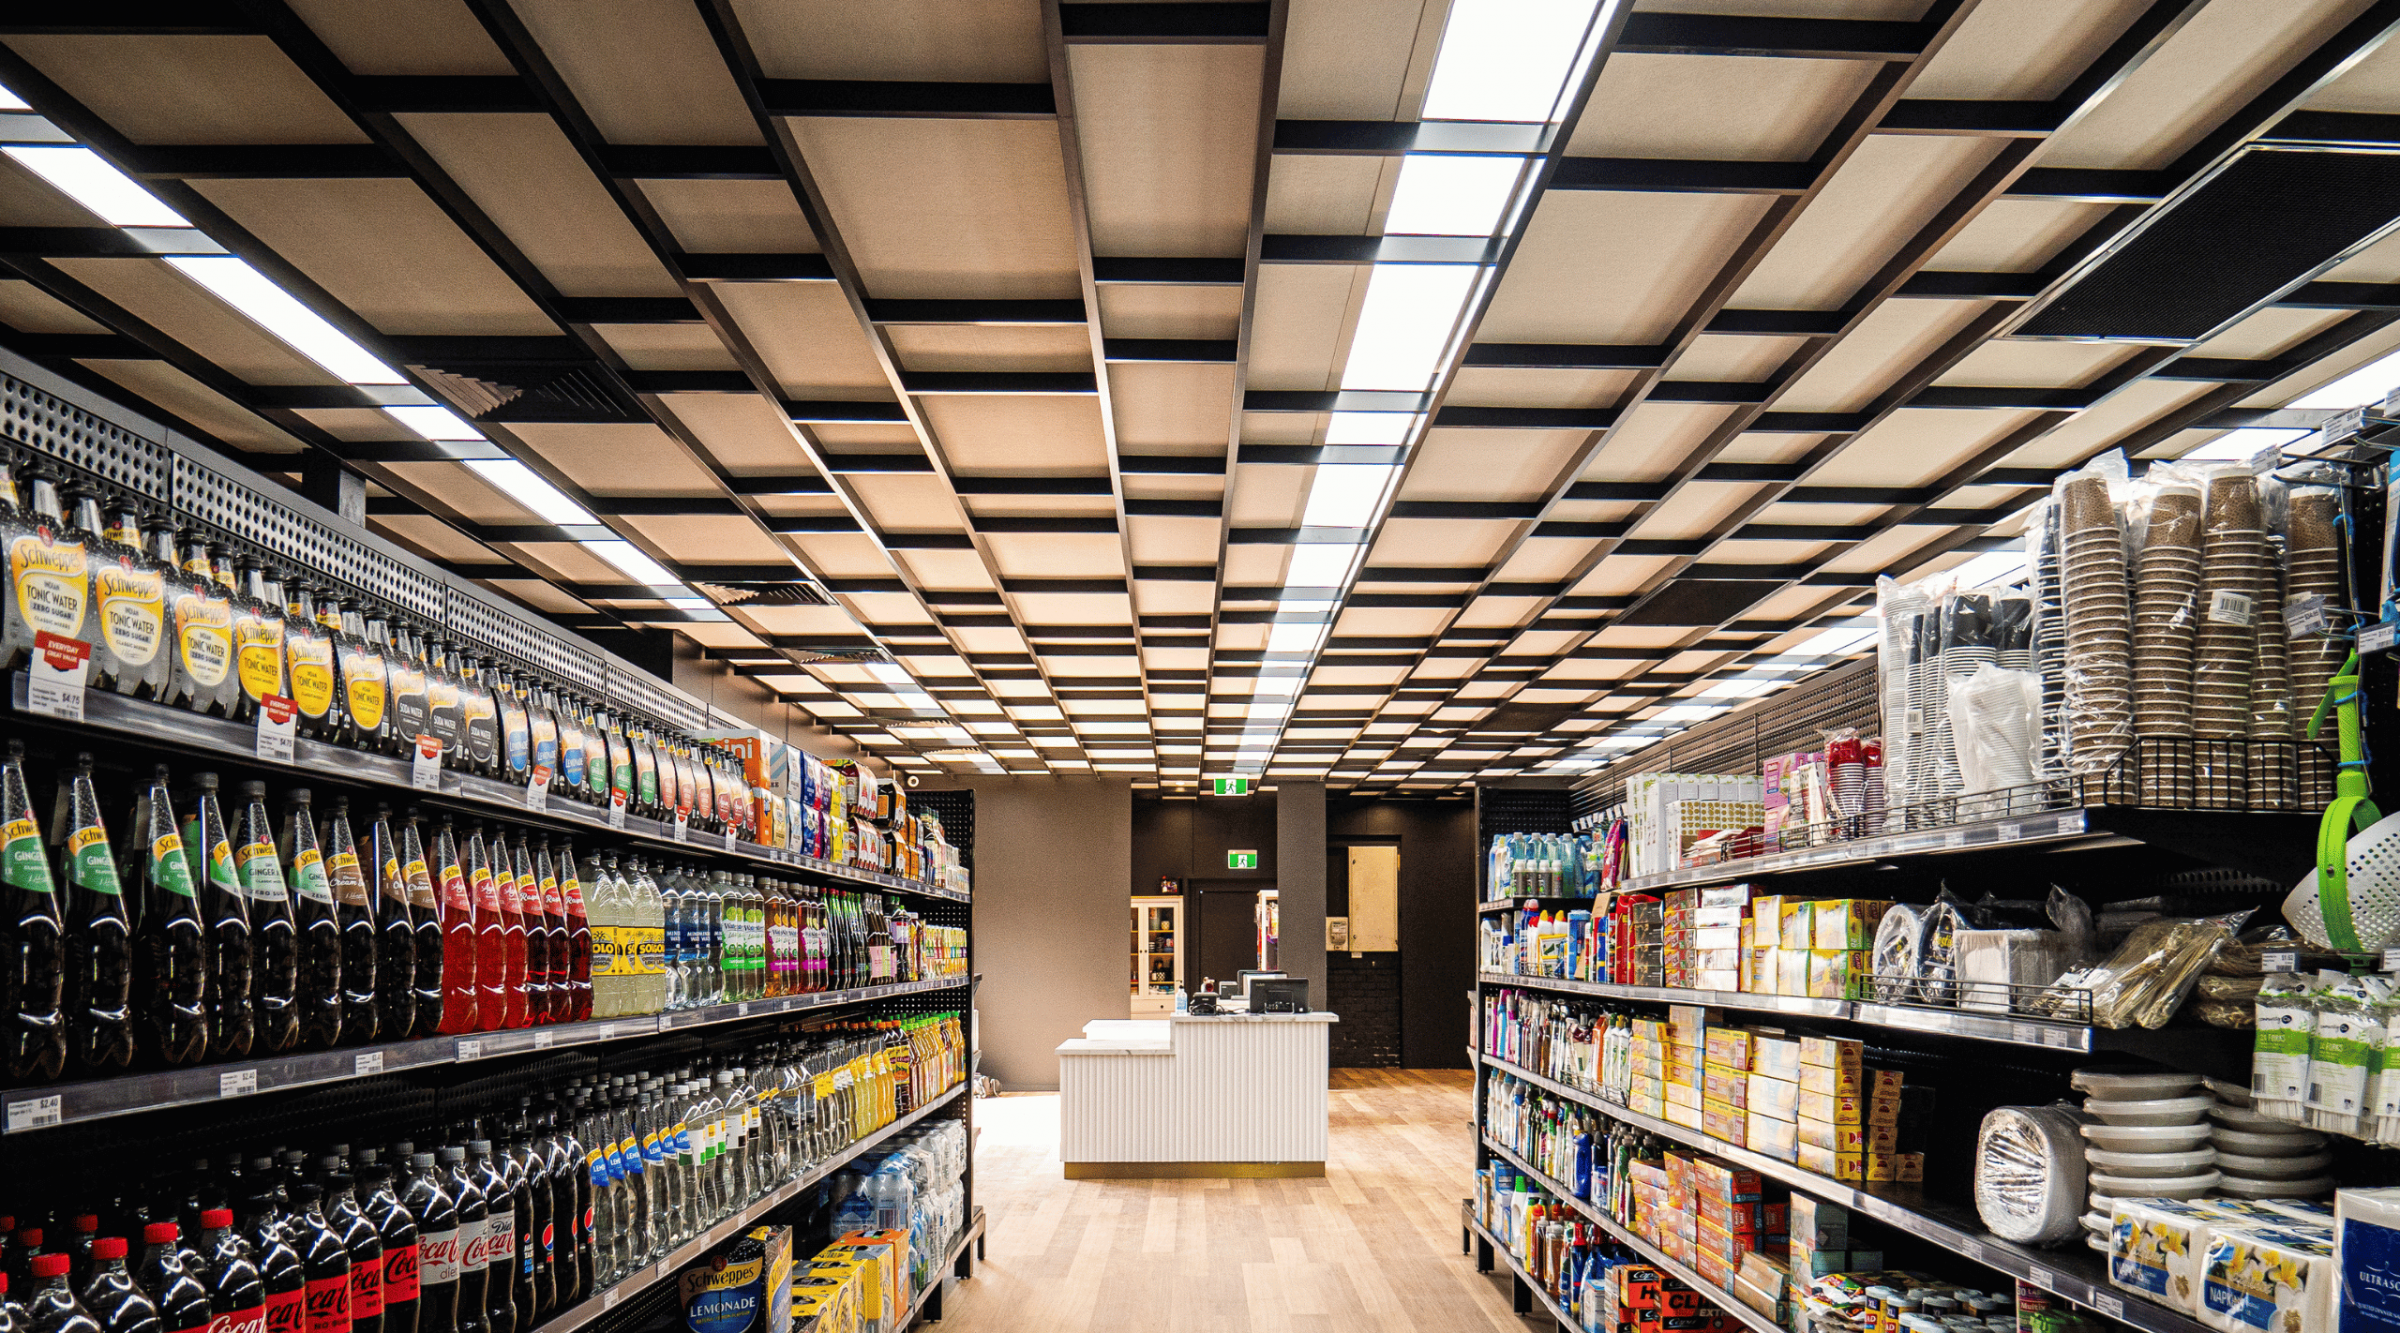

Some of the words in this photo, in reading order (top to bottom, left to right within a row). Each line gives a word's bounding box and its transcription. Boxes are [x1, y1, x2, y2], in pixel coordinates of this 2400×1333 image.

[20, 543, 81, 573] Schweppes
[104, 573, 157, 602] Schweppes
[26, 584, 51, 602] TONIC
[51, 593, 78, 612] WATER
[32, 603, 50, 614] ZERO
[51, 607, 74, 620] SUGAR
[109, 611, 131, 629] TONIC
[132, 618, 155, 635] WATER
[46, 650, 62, 660] GREAT
[62, 653, 78, 663] VALUE
[47, 640, 79, 654] EVERYDAY
[187, 636, 206, 652] TONIC
[206, 643, 225, 658] WATER
[244, 657, 261, 673] TONIC
[261, 662, 278, 677] WATER
[62, 693, 80, 705] $4.75
[15, 851, 43, 862] GINGE
[593, 943, 614, 954] OLO
[687, 1266, 755, 1293] Schweppes
[690, 1296, 756, 1318] LEMONADE
[1868, 1300, 1877, 1309] XL
